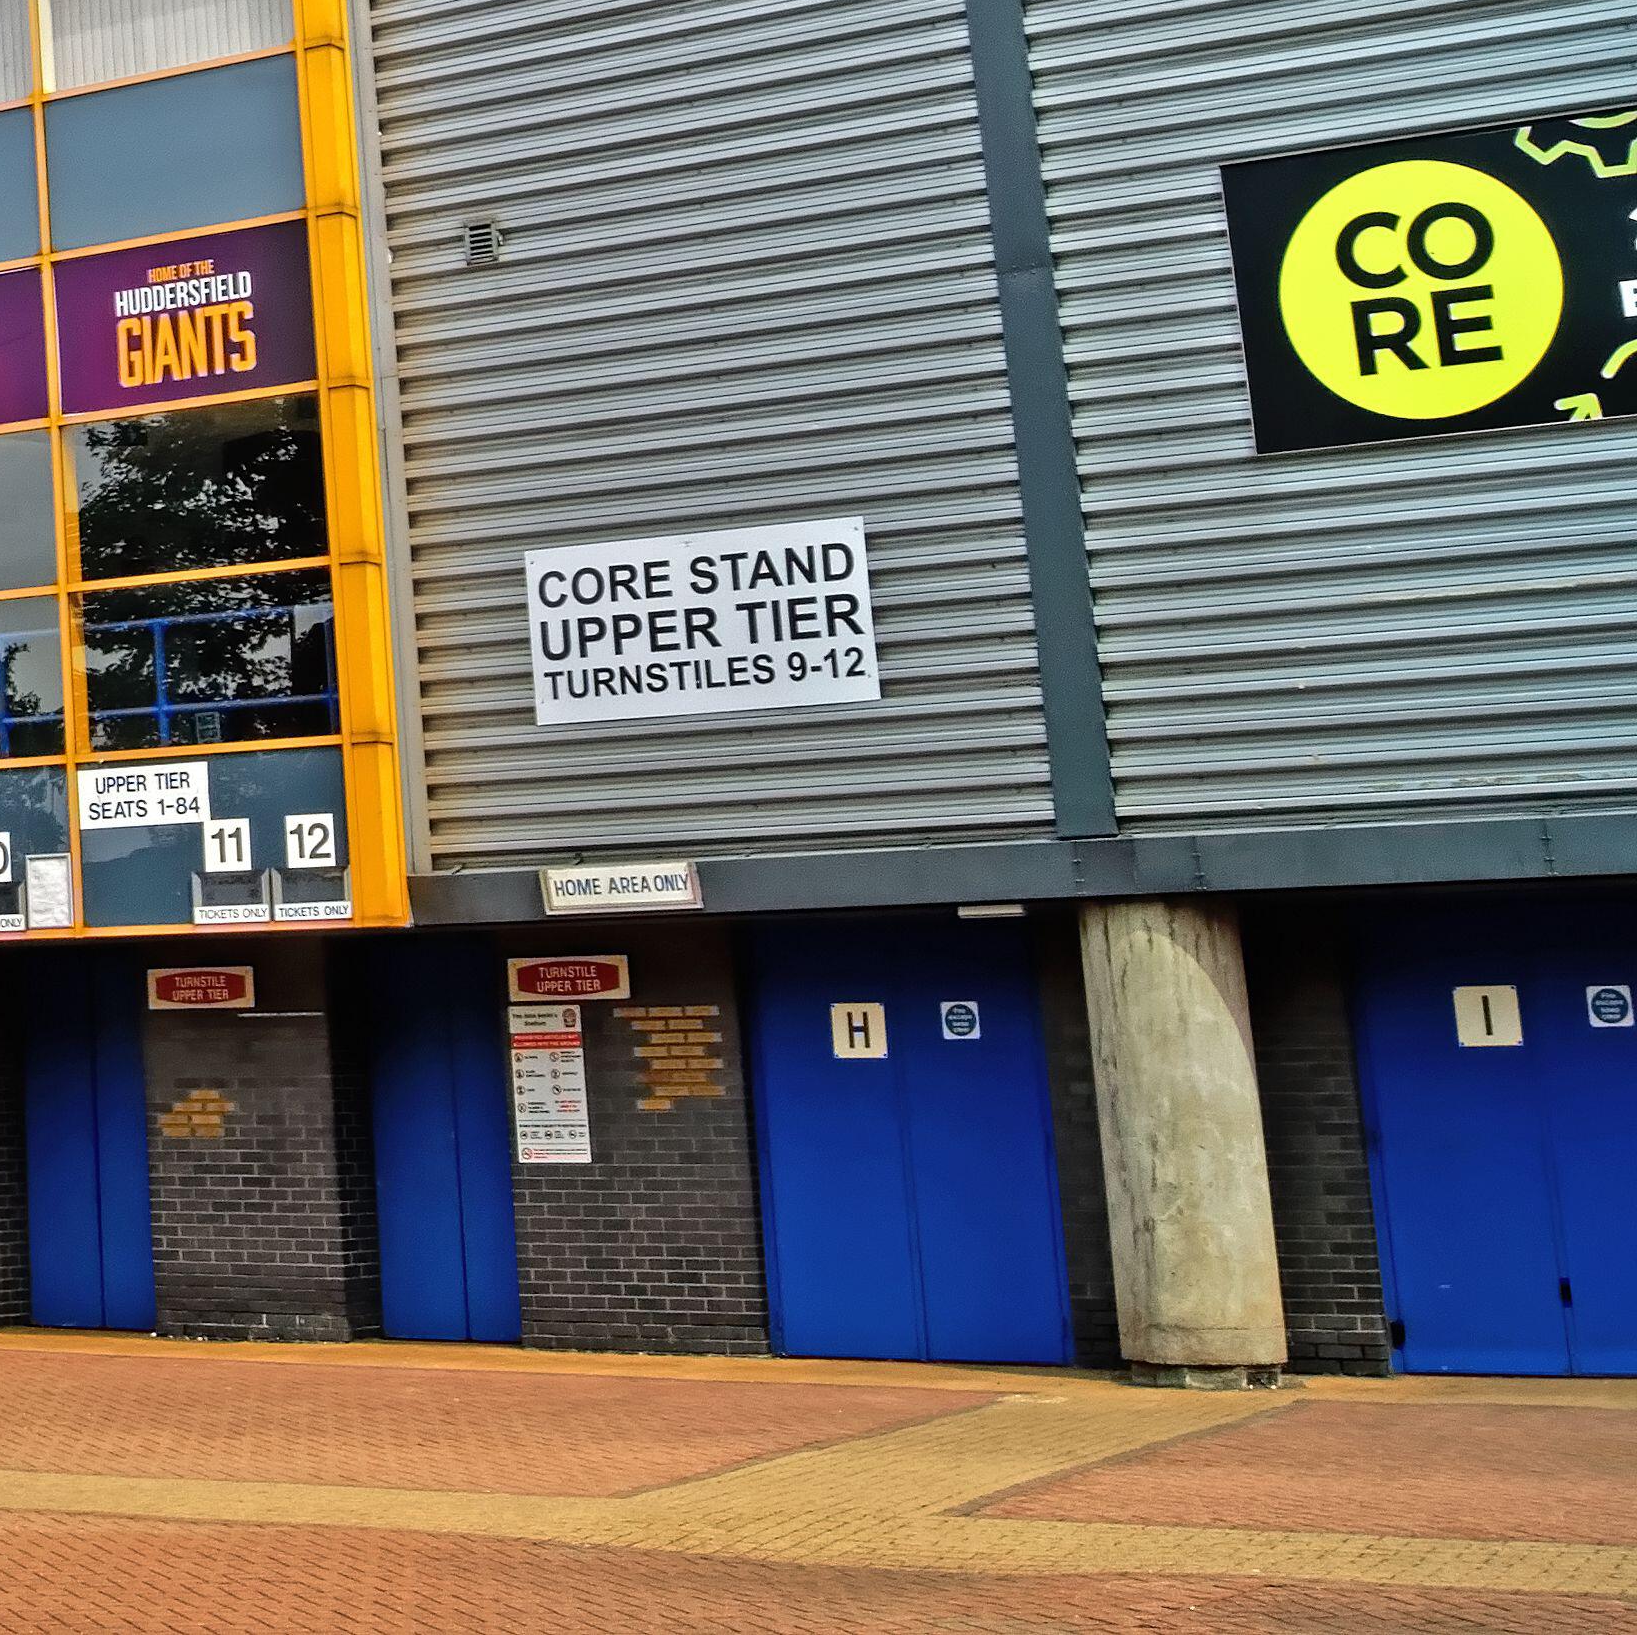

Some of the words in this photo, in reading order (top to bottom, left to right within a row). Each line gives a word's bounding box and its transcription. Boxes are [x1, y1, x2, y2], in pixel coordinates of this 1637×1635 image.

[1335, 201, 1494, 290] CO
[147, 265, 177, 283] HOME
[178, 262, 192, 279] OF
[193, 259, 215, 276] THE
[114, 271, 252, 317] HUDDERSFIELD
[1350, 283, 1504, 377] RE
[116, 300, 257, 388] GIANTS
[538, 560, 673, 608] CORE
[689, 542, 855, 596] STAND
[539, 607, 722, 661] UPPER
[736, 594, 865, 645] TIER
[544, 653, 776, 701] TURNSTILES
[788, 647, 867, 682] 9-12
[95, 774, 147, 795] UPPER
[154, 771, 190, 790] TIER
[89, 799, 148, 821] SEATS
[157, 796, 201, 816] 1-84
[211, 827, 243, 863] 11
[289, 822, 332, 859] 12
[554, 878, 602, 898] HOME
[607, 875, 652, 895] AREA
[653, 873, 689, 892] ONLY
[0, 918, 23, 928] ONLY
[198, 908, 240, 920] TICKETS
[242, 907, 268, 919] ONLY
[279, 906, 320, 918] TICKETS
[324, 905, 349, 917] ONLY
[174, 975, 227, 988] TURNSTILE
[539, 965, 598, 979] TURNSTILE
[172, 989, 204, 1001] UPPER
[206, 989, 229, 1000] TIER
[536, 980, 572, 993] UPPER
[575, 979, 602, 991] TIER
[846, 1011, 872, 1050] H
